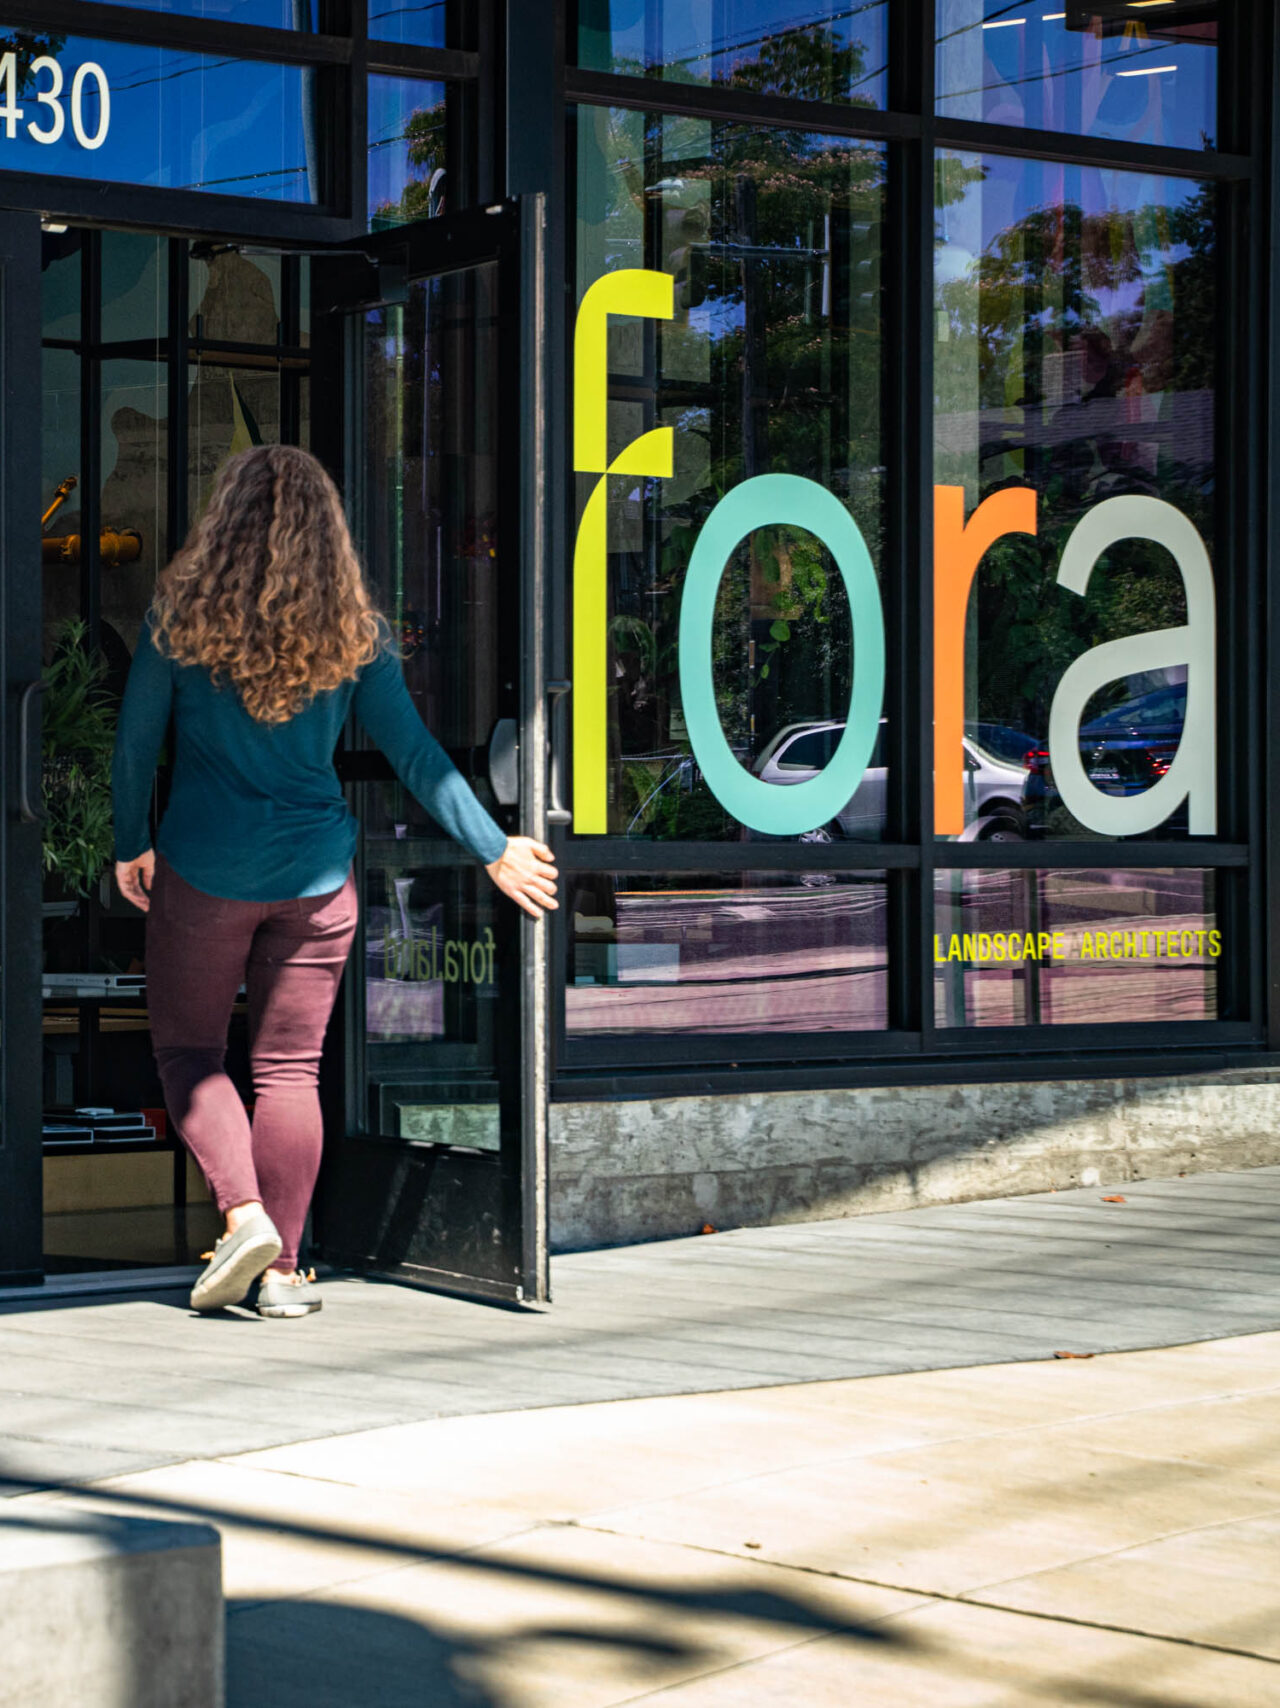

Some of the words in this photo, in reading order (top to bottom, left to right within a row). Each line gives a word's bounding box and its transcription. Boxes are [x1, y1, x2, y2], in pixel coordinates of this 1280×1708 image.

[573, 268, 1218, 837] fora
[933, 932, 1065, 962] LANDSCAPE
[1080, 929, 1222, 958] ARCHITECTS
